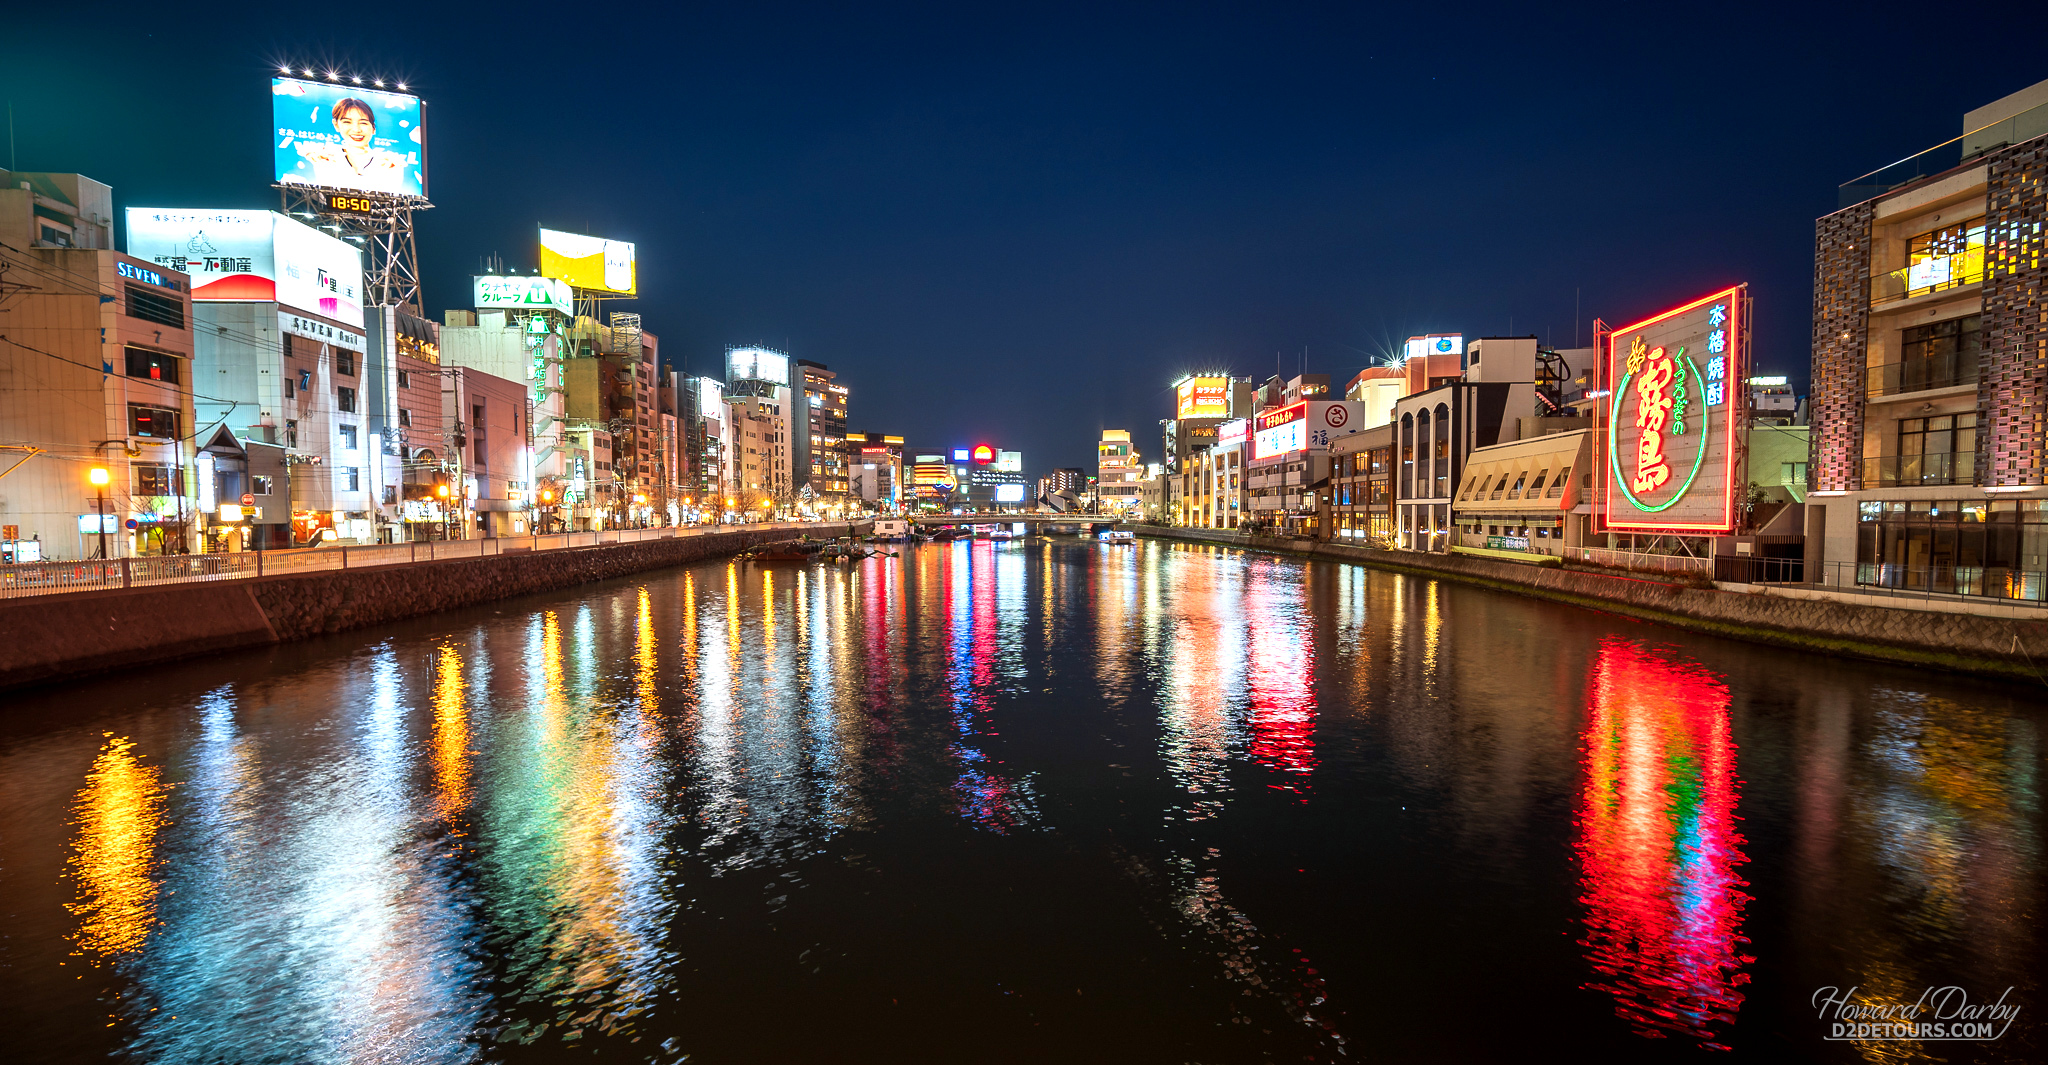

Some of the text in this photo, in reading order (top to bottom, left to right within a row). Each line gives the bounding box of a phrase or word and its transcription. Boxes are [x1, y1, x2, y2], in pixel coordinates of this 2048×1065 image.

[332, 197, 370, 211] 18:50
[117, 261, 161, 286] SEVEN
[293, 317, 333, 338] SEVEN
[1706, 303, 1726, 406] 本格焼酎
[1195, 386, 1225, 394] カラオケ
[1672, 346, 1687, 435] くつろぎの
[1633, 346, 1673, 494] 霧島
